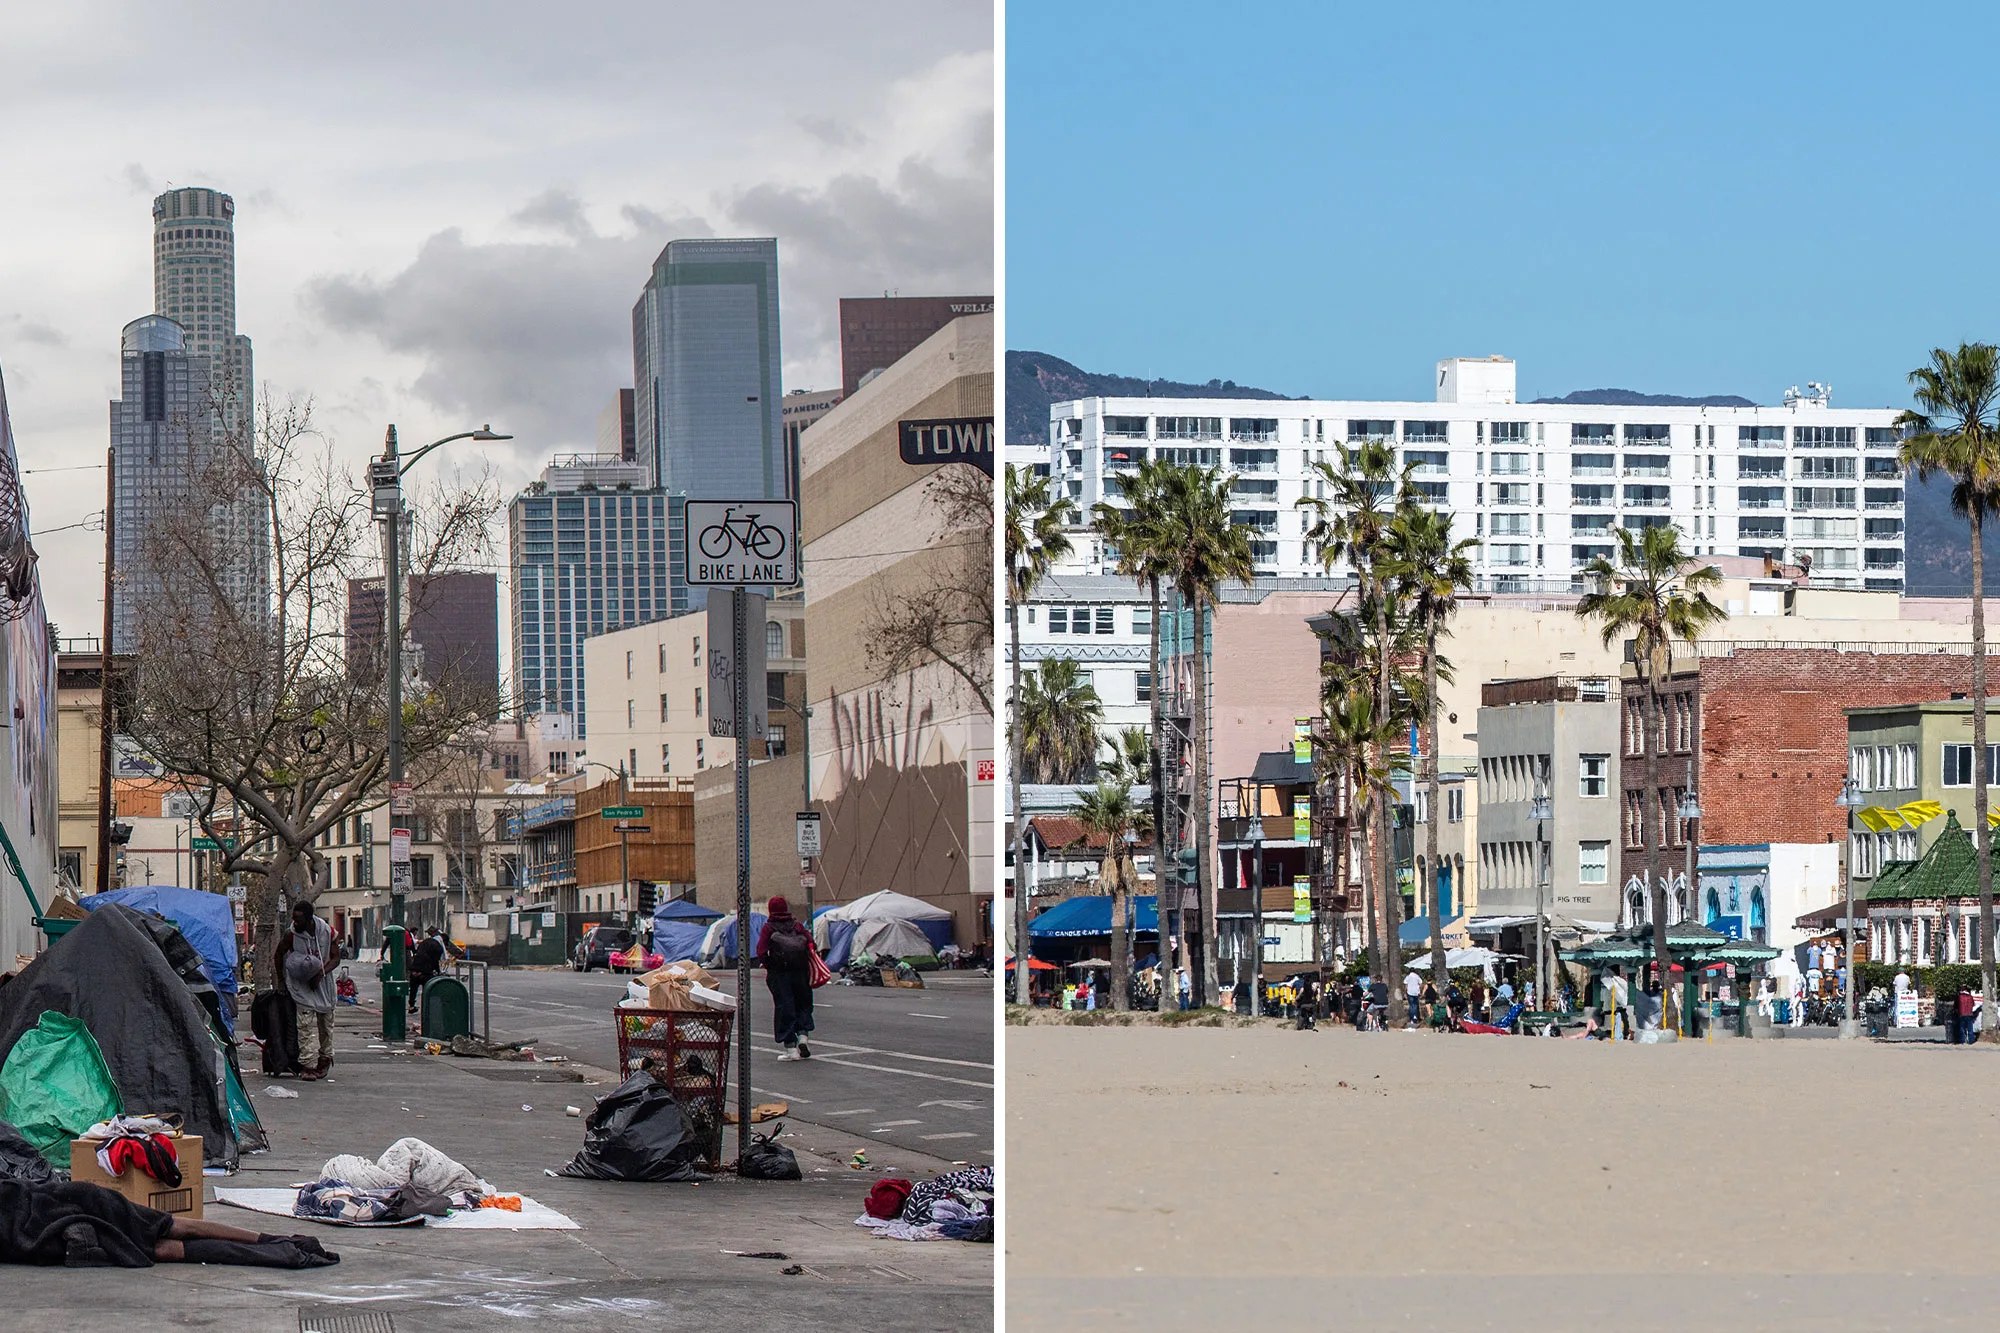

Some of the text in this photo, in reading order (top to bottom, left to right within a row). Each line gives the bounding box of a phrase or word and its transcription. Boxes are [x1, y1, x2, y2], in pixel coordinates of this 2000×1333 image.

[950, 303, 994, 313] WELLS
[794, 402, 830, 413] AMERICA
[699, 564, 783, 580] BIKE LANE
[361, 580, 385, 590] CBRE
[978, 761, 994, 772] FDC
[1572, 896, 1592, 904] TREE
